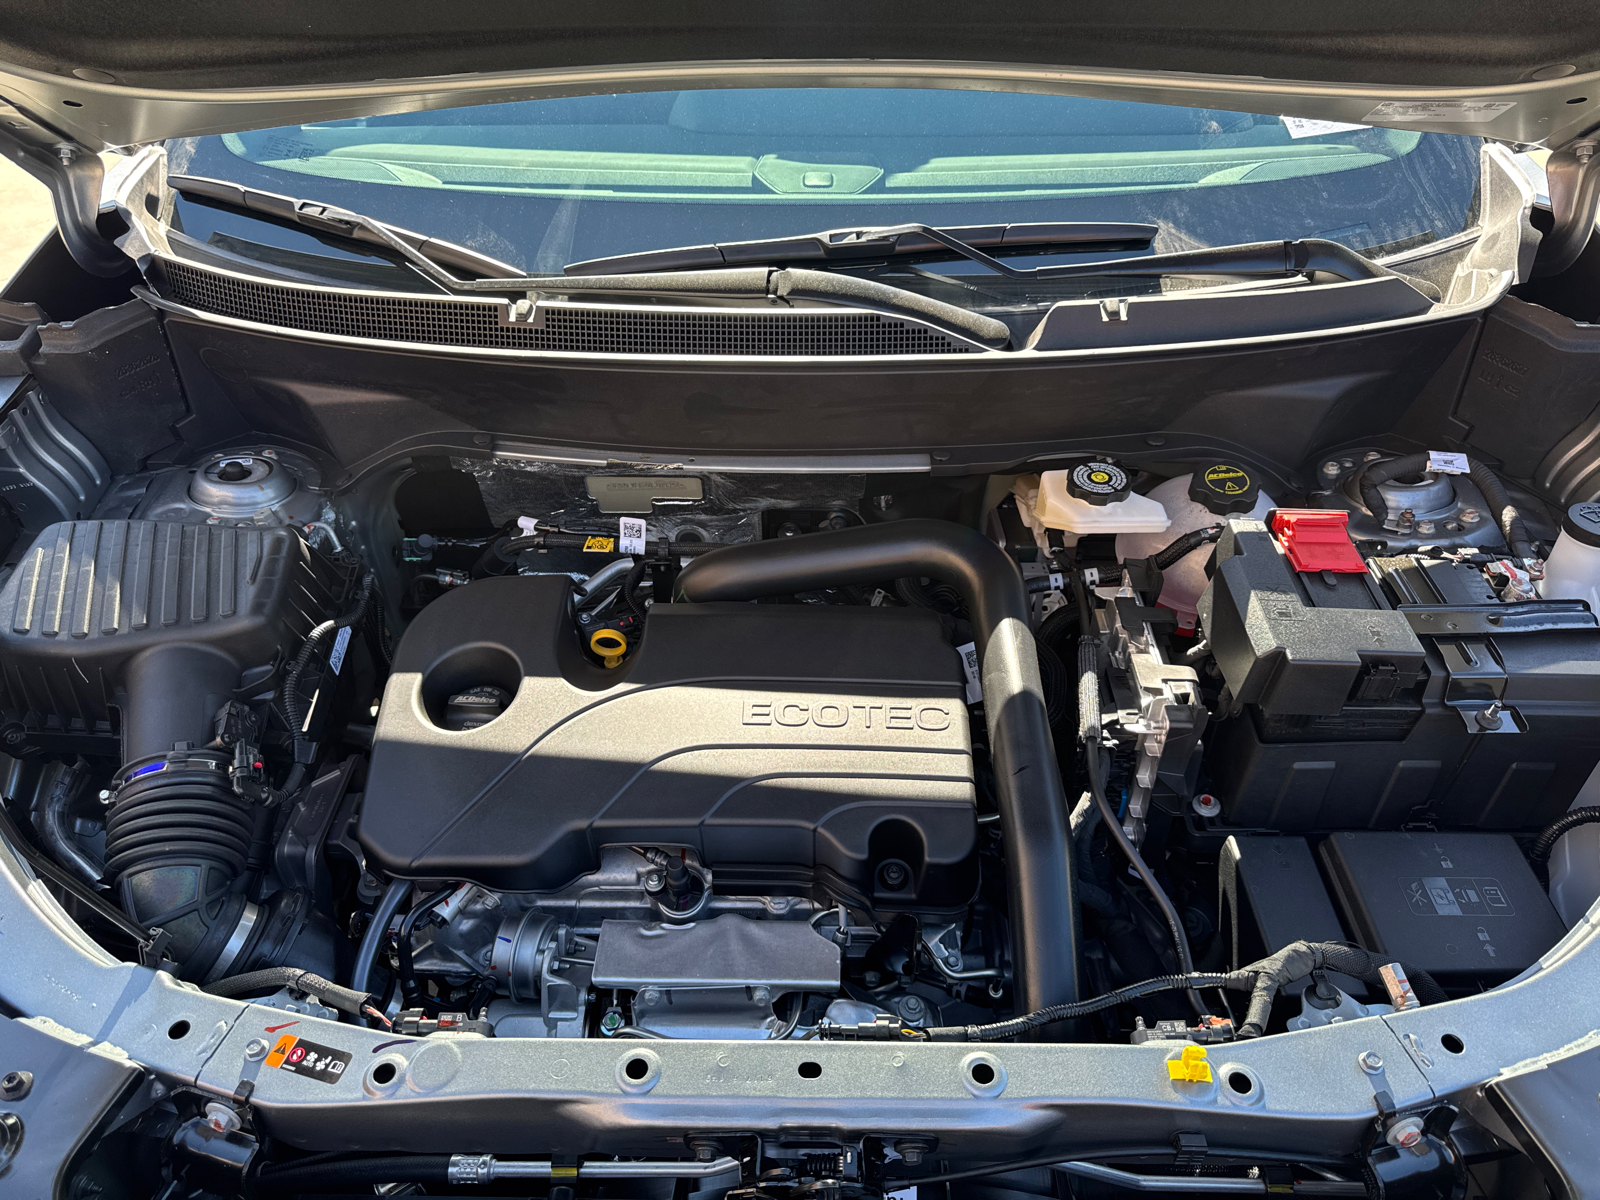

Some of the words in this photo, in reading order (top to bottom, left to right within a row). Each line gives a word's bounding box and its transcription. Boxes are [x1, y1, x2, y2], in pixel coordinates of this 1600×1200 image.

[1207, 472, 1244, 480] ACDelco
[483, 687, 500, 696] 0W-20
[453, 695, 497, 704] ACDelco
[741, 700, 951, 732] ECOTEC
[301, 1059, 315, 1068] AUTO
